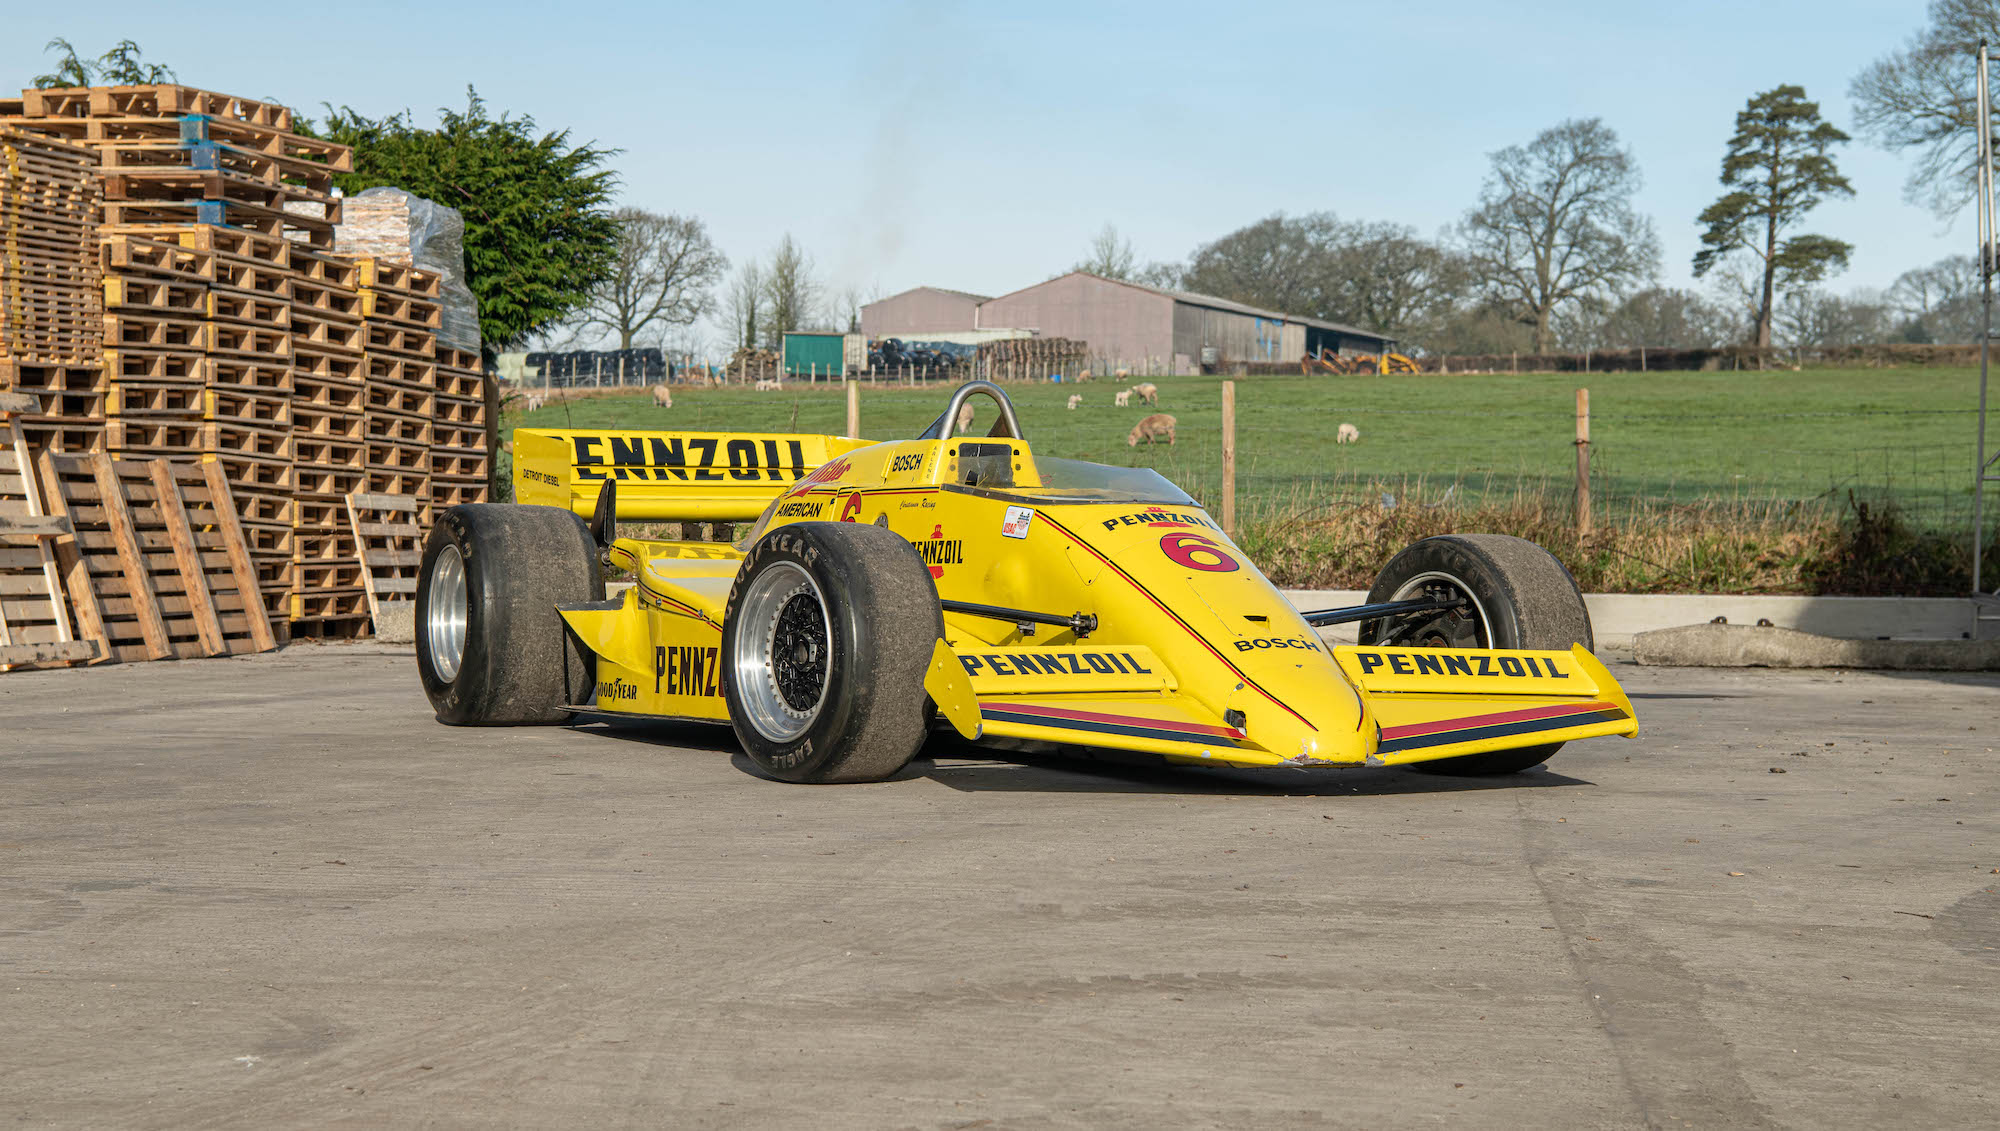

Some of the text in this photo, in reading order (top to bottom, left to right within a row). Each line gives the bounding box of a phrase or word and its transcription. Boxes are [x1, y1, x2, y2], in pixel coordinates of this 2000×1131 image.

[546, 436, 805, 481] ENNZOIL
[892, 453, 924, 472] BOSCH
[523, 469, 559, 487] DETROIT DIESEL
[775, 502, 823, 517] AMERICAN
[1102, 513, 1219, 531] PENNZOIL
[911, 540, 963, 564] ENNZOIL
[1160, 532, 1240, 572] 6
[1233, 638, 1322, 652] BOSCH
[655, 646, 725, 697] PENNZ
[957, 653, 1152, 677] PENNZOIL
[1355, 652, 1569, 679] PENNZOIL
[597, 677, 637, 702] GOODYEAR
[771, 738, 814, 769] EAGLE
